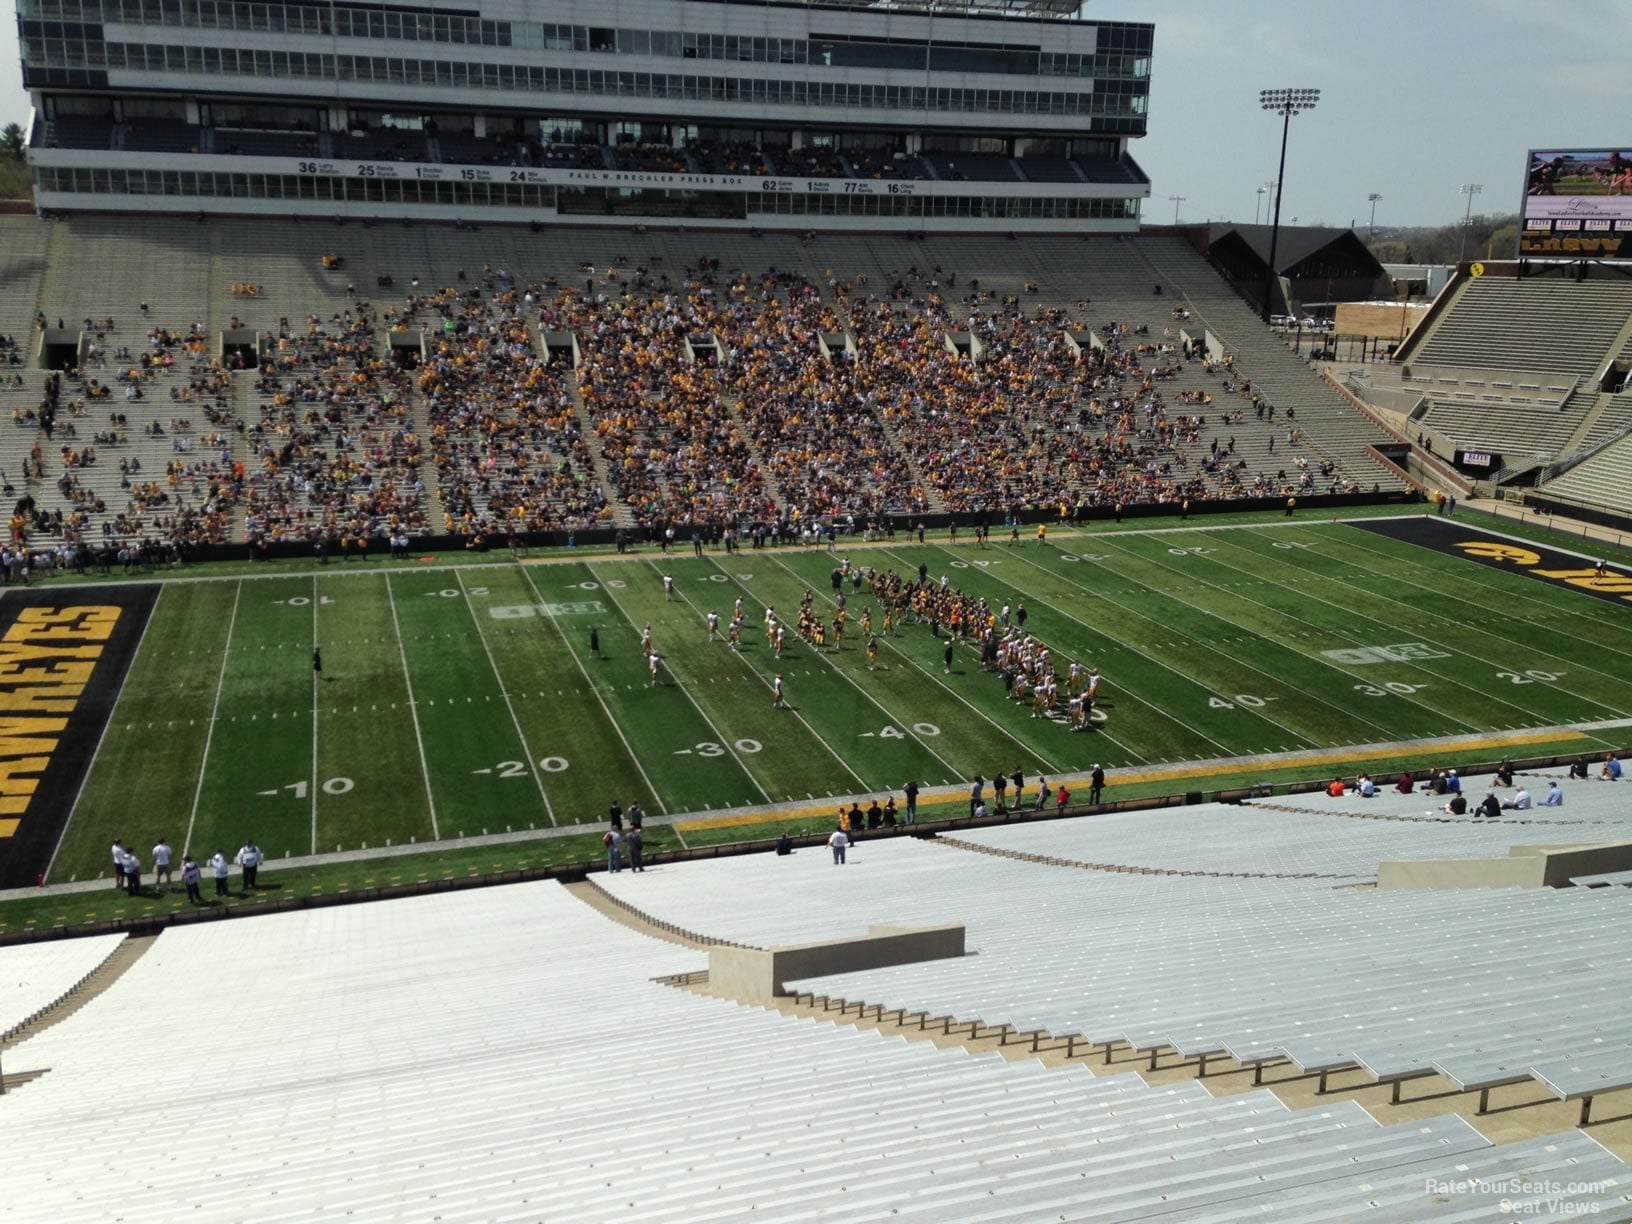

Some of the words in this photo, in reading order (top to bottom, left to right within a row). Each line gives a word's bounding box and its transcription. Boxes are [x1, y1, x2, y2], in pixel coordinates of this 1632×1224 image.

[299, 162, 317, 173] 36
[357, 164, 375, 176] 25
[416, 167, 421, 178] 1
[461, 169, 475, 180] 15
[510, 170, 526, 181] 24
[569, 172, 597, 180] PAUL
[616, 174, 674, 182] BRECHLER
[681, 176, 714, 184] PRESS
[763, 180, 777, 191] 62
[808, 182, 813, 191] 1
[844, 182, 857, 193] 77
[887, 183, 899, 194] 16
